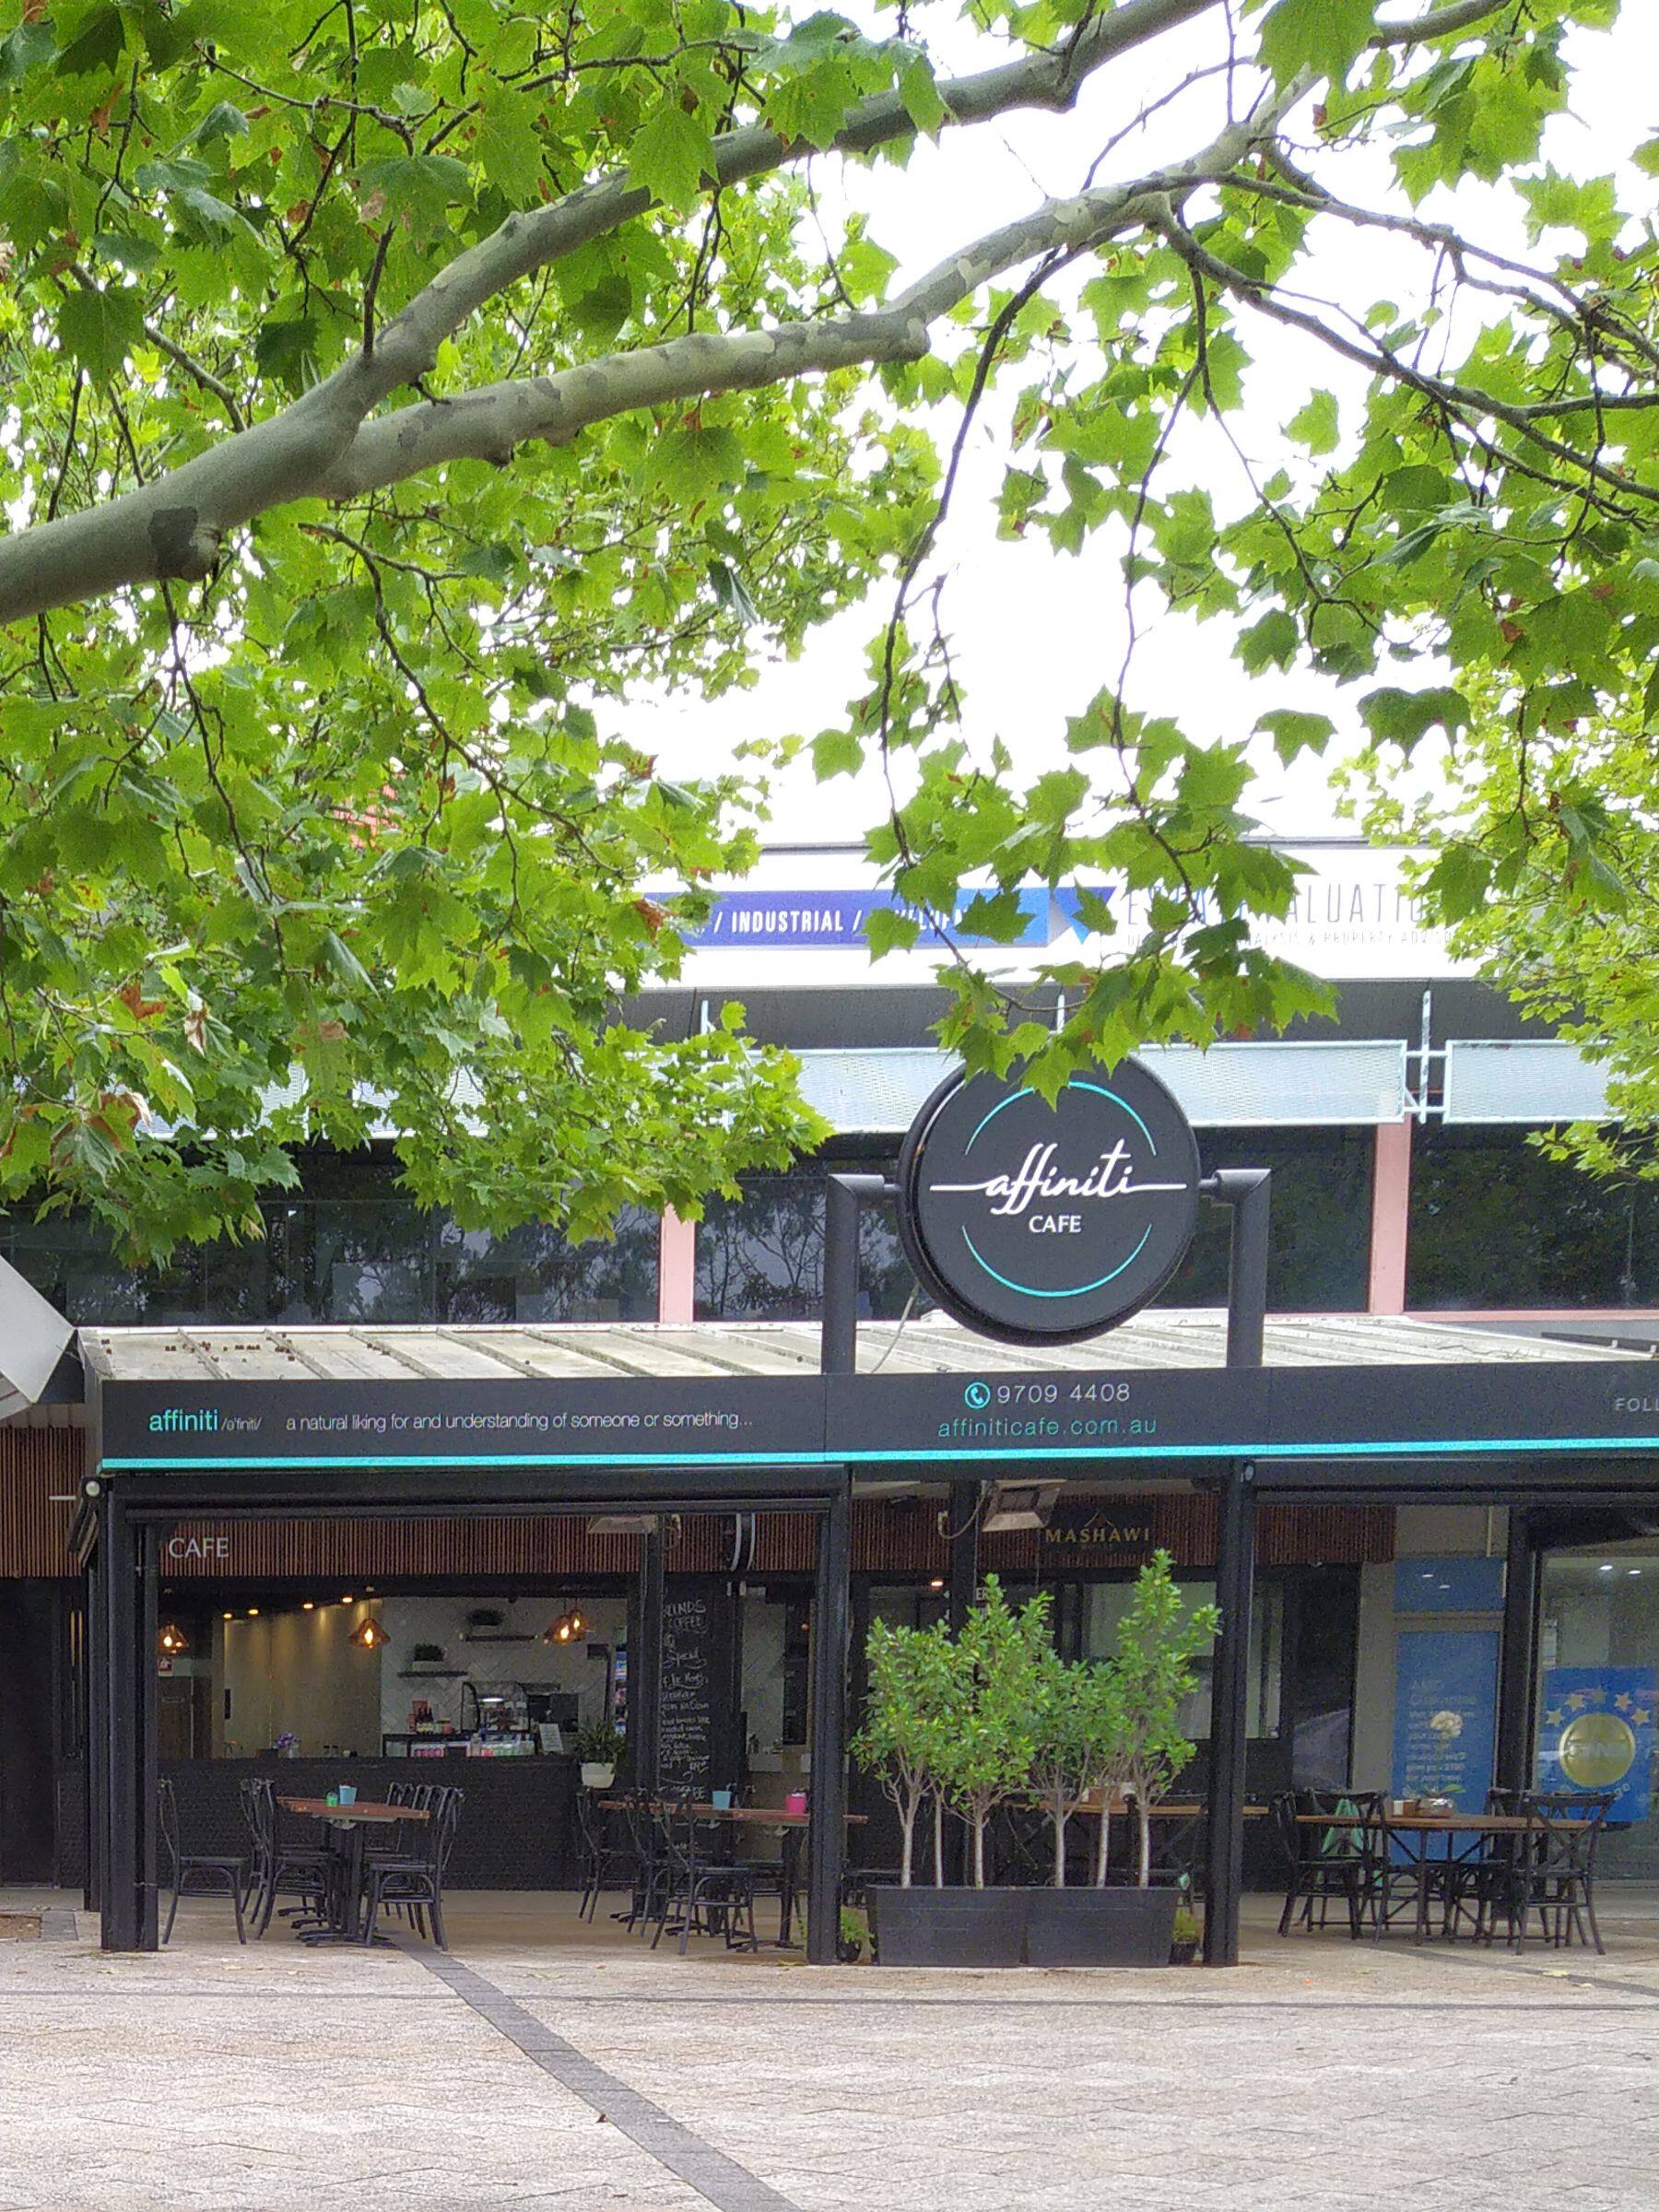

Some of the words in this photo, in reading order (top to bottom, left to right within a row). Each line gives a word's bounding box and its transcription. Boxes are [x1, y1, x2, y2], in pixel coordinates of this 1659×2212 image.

[1265, 882, 1424, 924] ALUATIO
[732, 909, 843, 934] INDUSTRIAL
[930, 1139, 1187, 1215] affiniti
[1029, 1215, 1082, 1233] CAFE
[997, 1384, 1058, 1403] 9709
[1069, 1383, 1131, 1402] 4408
[149, 1409, 219, 1430] affiniti
[286, 1418, 296, 1430] a
[300, 1415, 348, 1430] natural
[352, 1414, 386, 1433] liking
[391, 1413, 409, 1429] for
[413, 1413, 441, 1429] and
[445, 1412, 548, 1431] understanding
[553, 1412, 568, 1428] of
[571, 1414, 641, 1428] someone
[644, 1415, 659, 1428] or
[938, 1418, 1158, 1438] affiniticafe.com.au
[1045, 1527, 1149, 1544] MASHAWI
[169, 1537, 229, 1559] CAFE
